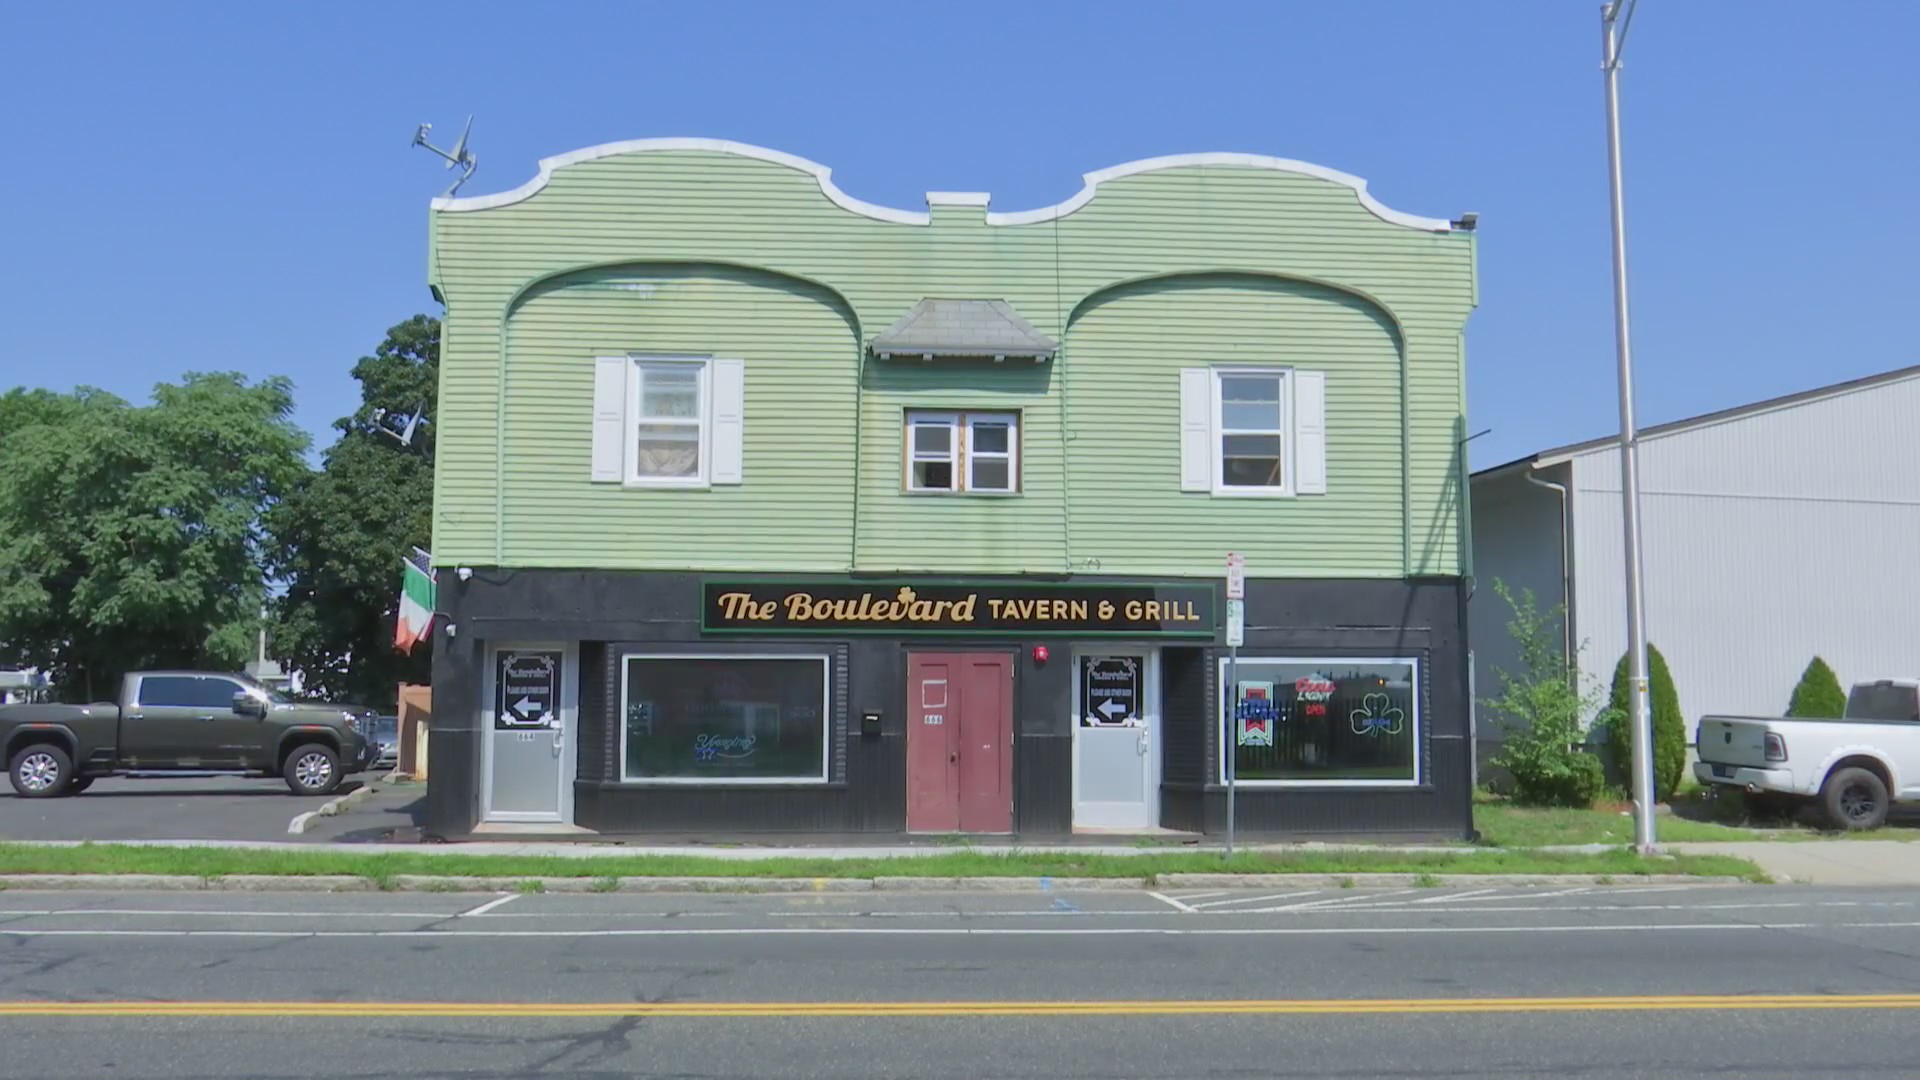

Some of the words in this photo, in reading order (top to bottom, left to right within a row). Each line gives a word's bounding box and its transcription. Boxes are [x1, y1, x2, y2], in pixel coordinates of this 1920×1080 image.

[717, 592, 778, 620] The
[783, 590, 978, 622] Boulevard
[988, 599, 1088, 620] TAVERN
[1097, 599, 1116, 620] &
[1125, 600, 1200, 621] GRILL
[1295, 677, 1336, 692] Coors
[1296, 691, 1333, 701] LIGHT
[1306, 703, 1326, 715] OPEN
